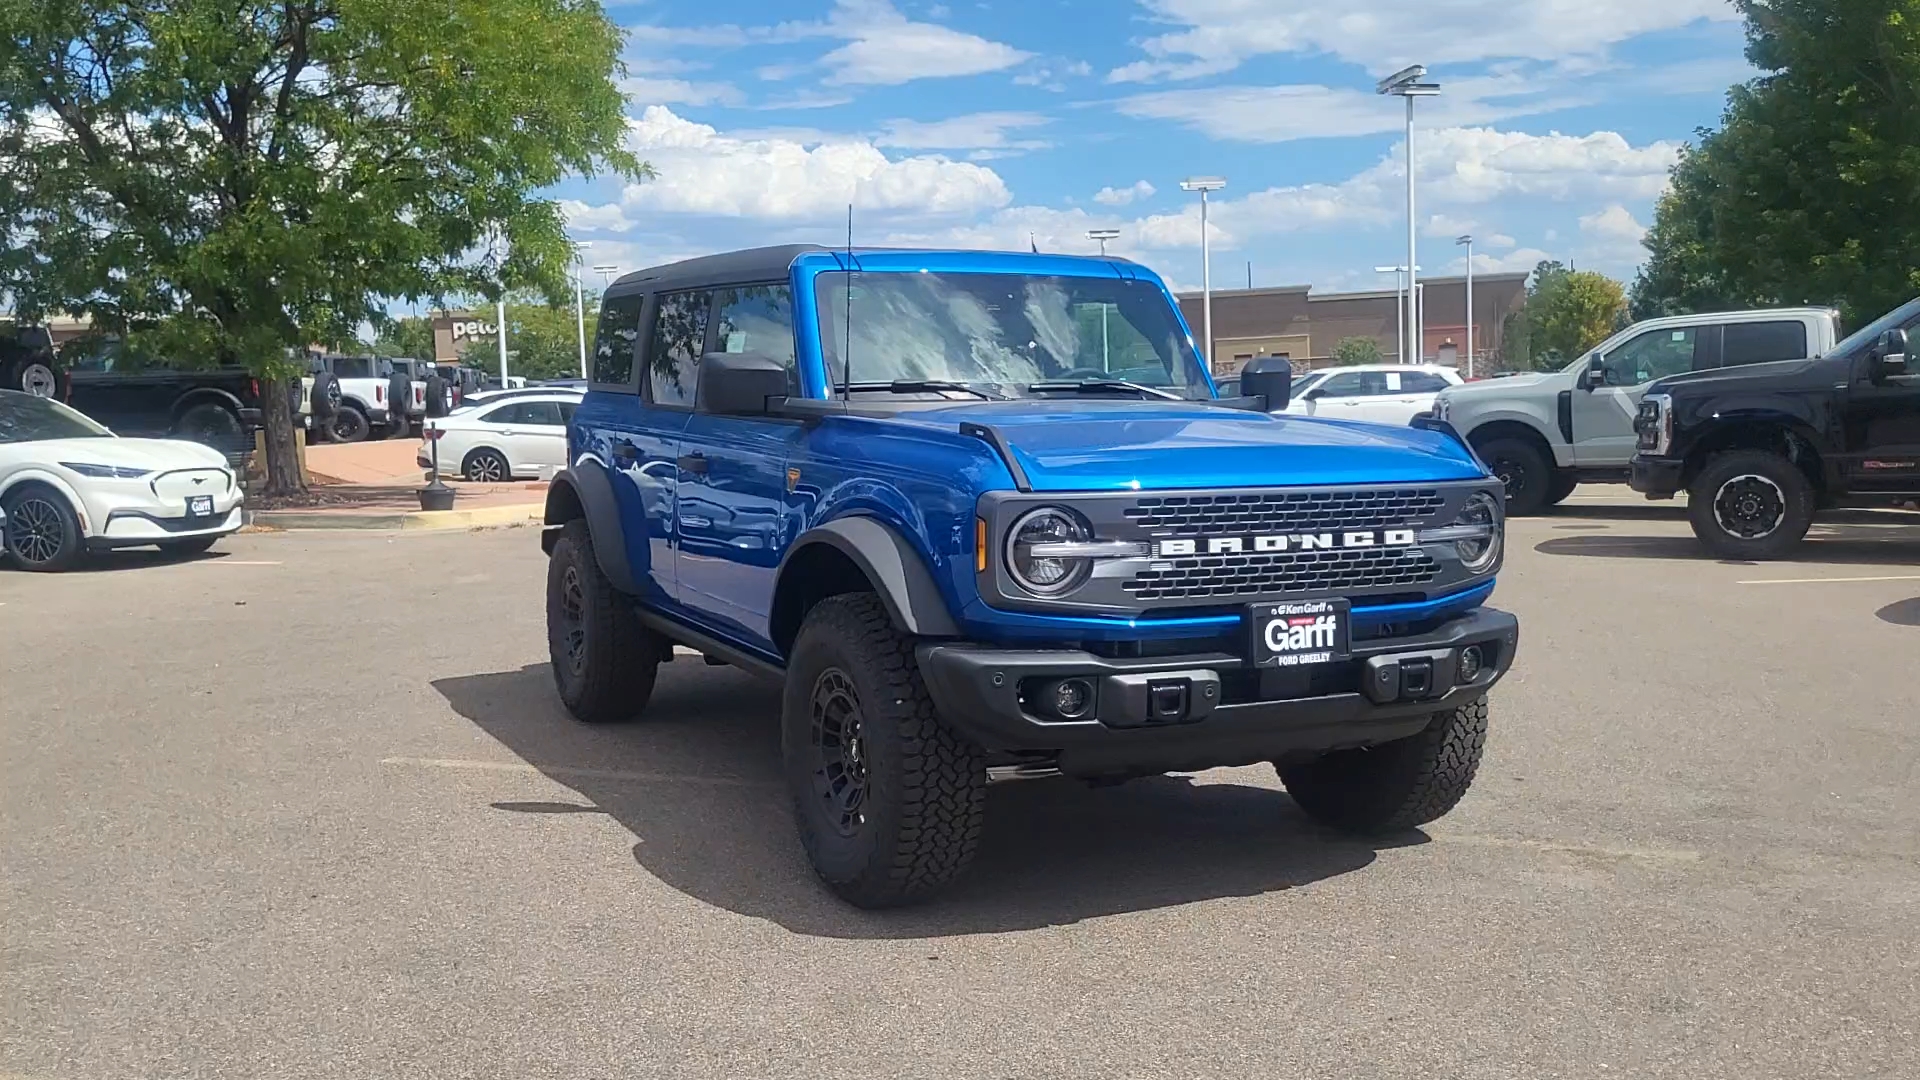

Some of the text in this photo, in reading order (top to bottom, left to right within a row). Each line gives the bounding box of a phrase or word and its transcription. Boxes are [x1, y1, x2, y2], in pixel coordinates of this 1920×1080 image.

[452, 320, 509, 340] petc
[1160, 529, 1415, 556] BRONCO
[1264, 615, 1337, 652] Garff
[1278, 652, 1331, 666] FORD GREELEY
